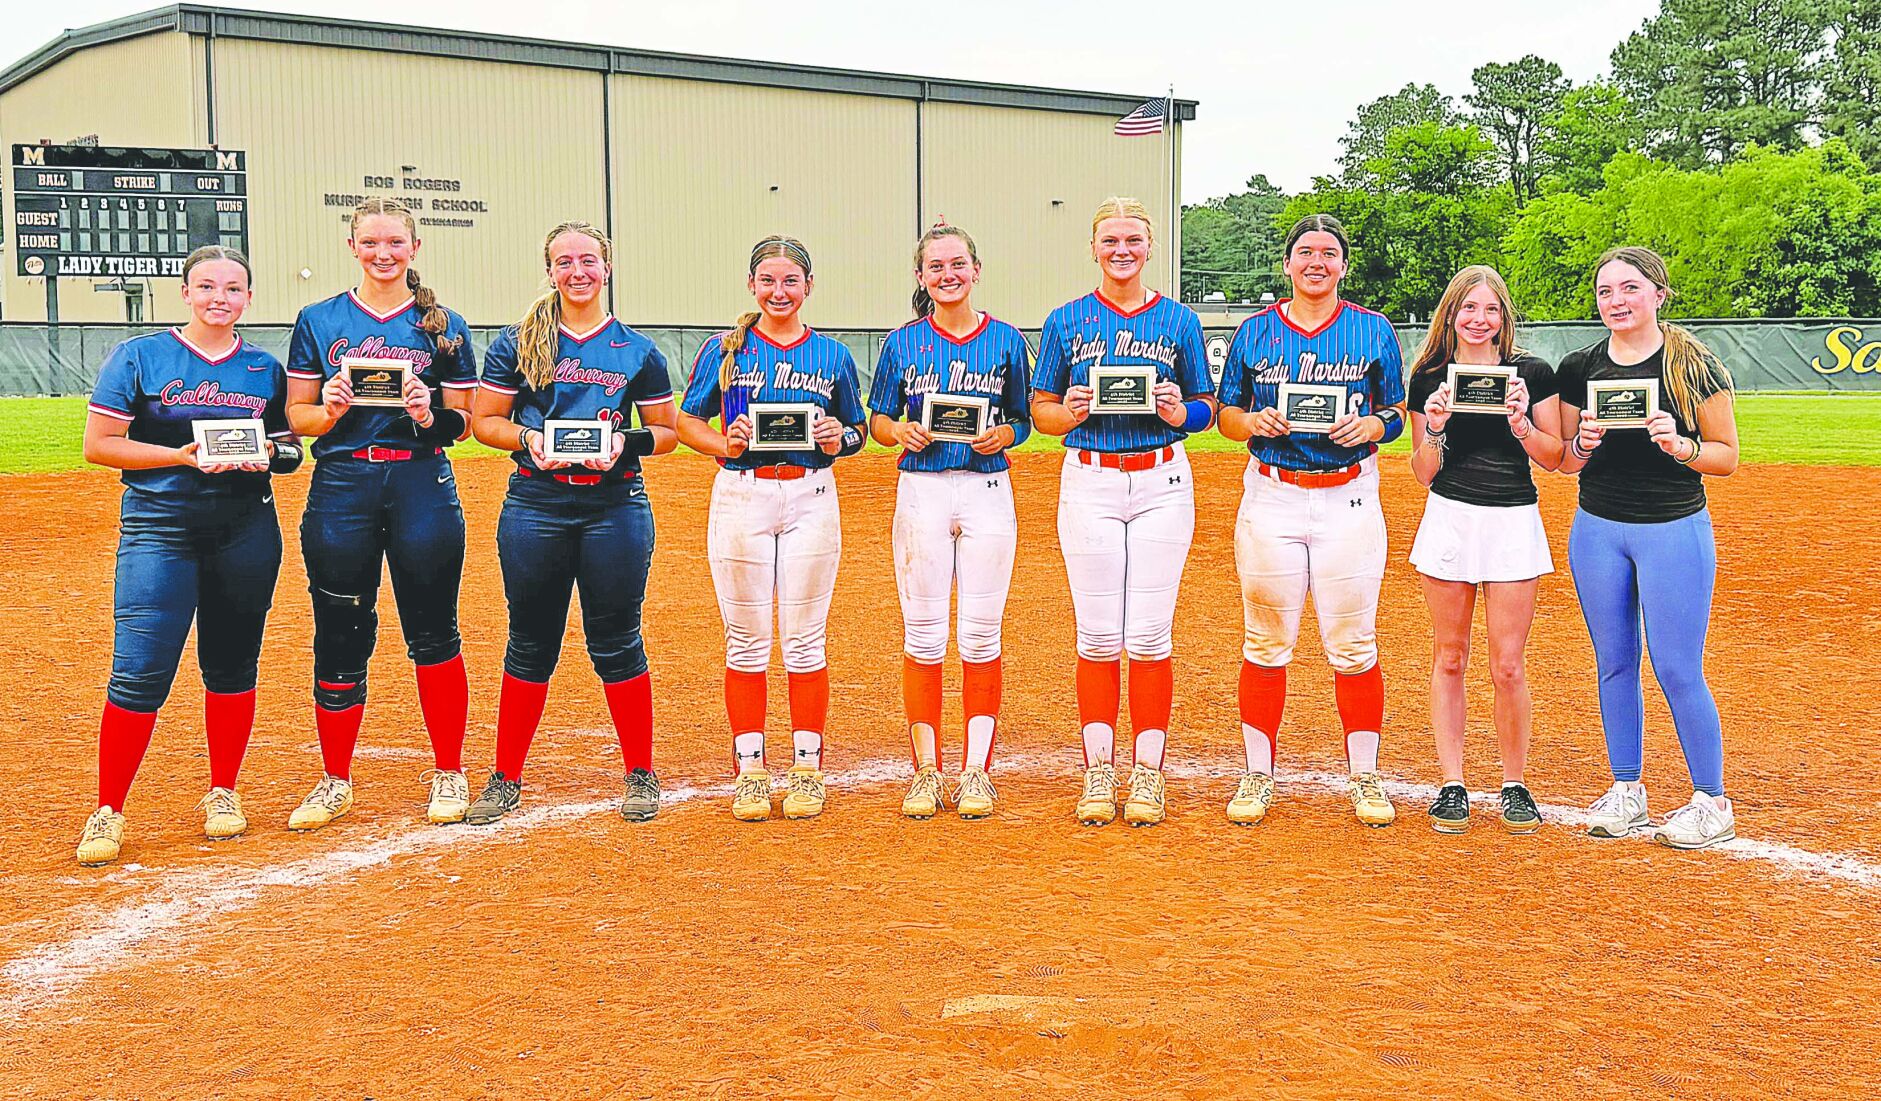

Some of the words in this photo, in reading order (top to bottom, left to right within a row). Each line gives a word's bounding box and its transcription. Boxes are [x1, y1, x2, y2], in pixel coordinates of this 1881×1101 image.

[22, 147, 45, 165] M
[215, 152, 238, 170] M
[38, 174, 67, 186] BALL
[114, 176, 156, 189] STRIKE
[197, 177, 220, 190] OUT
[364, 176, 394, 188] BOB
[403, 178, 460, 191] ROGERS
[60, 197, 67, 208] 1
[81, 198, 88, 208] 2
[120, 198, 128, 210] 4
[137, 199, 146, 210] 5
[178, 199, 186, 211] 7
[216, 200, 243, 211] RUNS
[324, 193, 383, 206] MURR
[432, 199, 488, 212] SCHOOL
[17, 212, 58, 225] GUEST
[19, 235, 58, 248] HOME
[58, 256, 101, 274] LADY
[105, 257, 158, 275] TIGER
[328, 336, 432, 374] Calloway
[1071, 332, 1106, 367] Lady
[553, 358, 628, 396] lloway
[1255, 355, 1289, 384] Lady
[730, 362, 765, 399] Lady
[905, 362, 939, 396] Lady
[161, 379, 266, 419] Calloway
